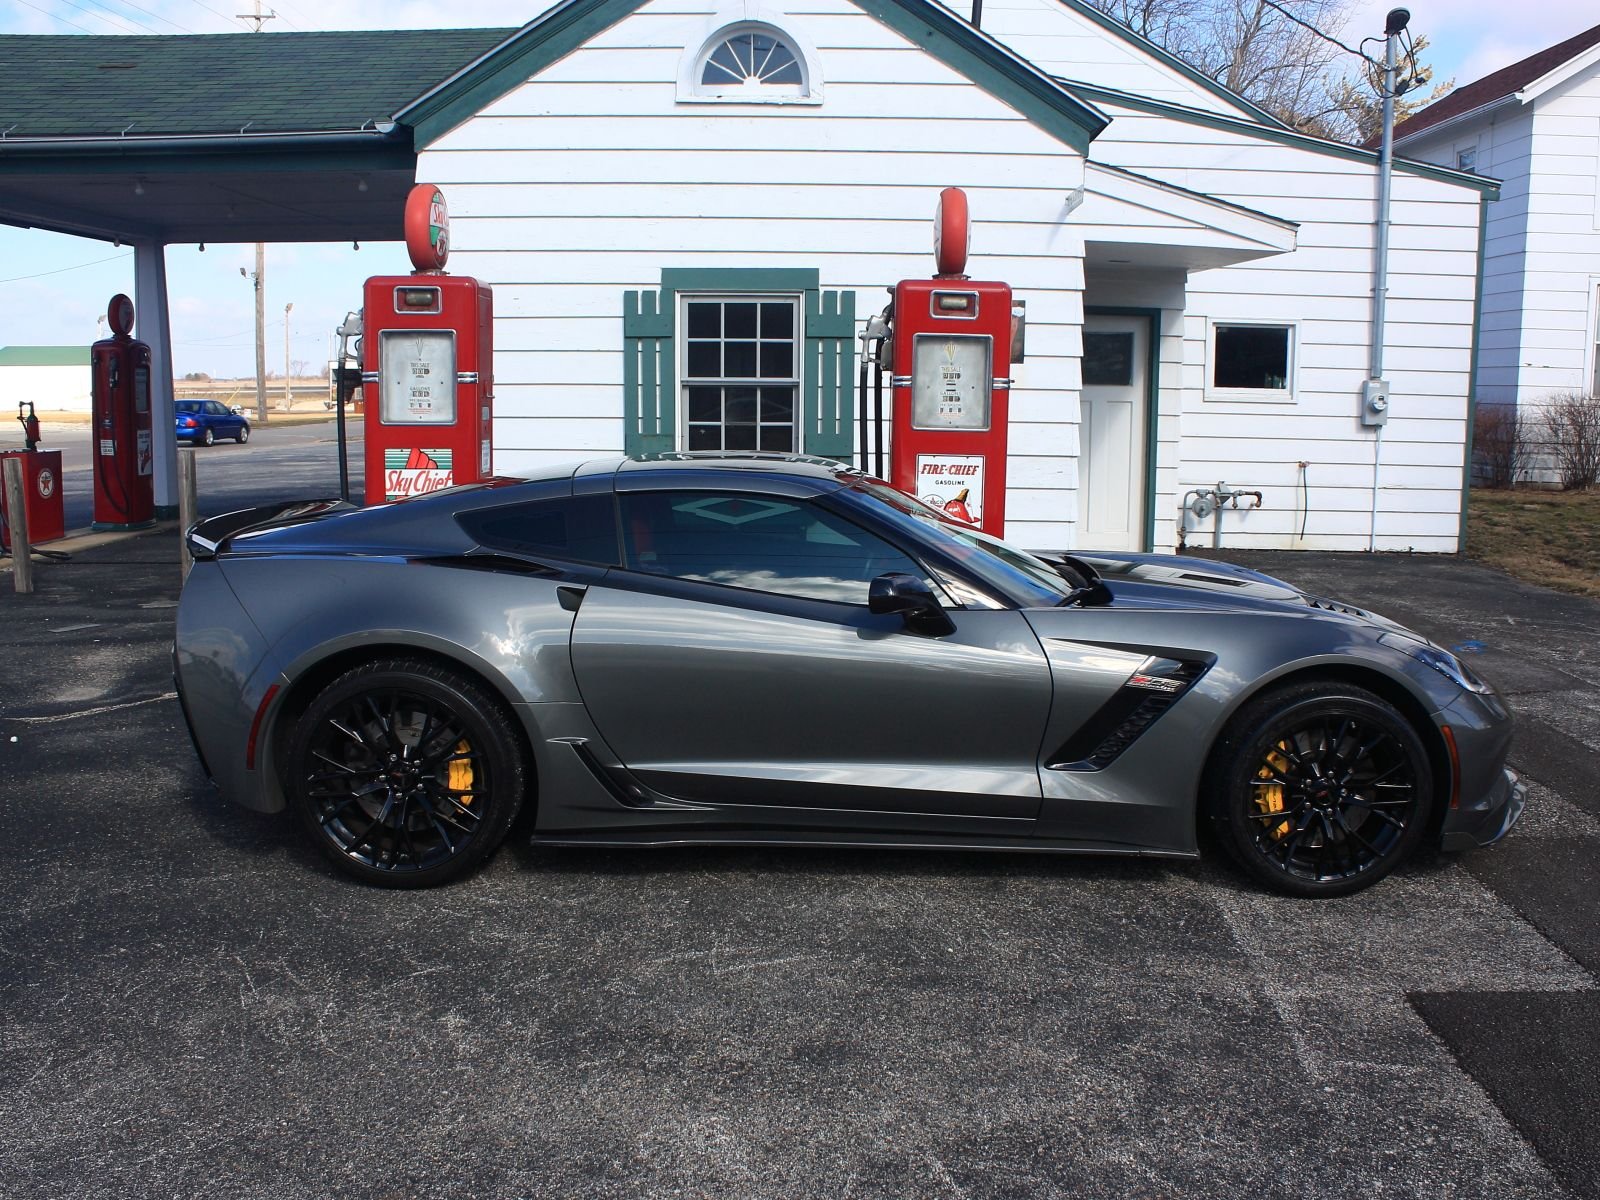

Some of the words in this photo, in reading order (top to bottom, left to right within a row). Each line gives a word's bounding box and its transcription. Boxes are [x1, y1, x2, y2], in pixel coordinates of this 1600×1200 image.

[921, 464, 979, 476] FIRE-CHIEF
[386, 470, 413, 495] Sky
[413, 470, 453, 493] Chief
